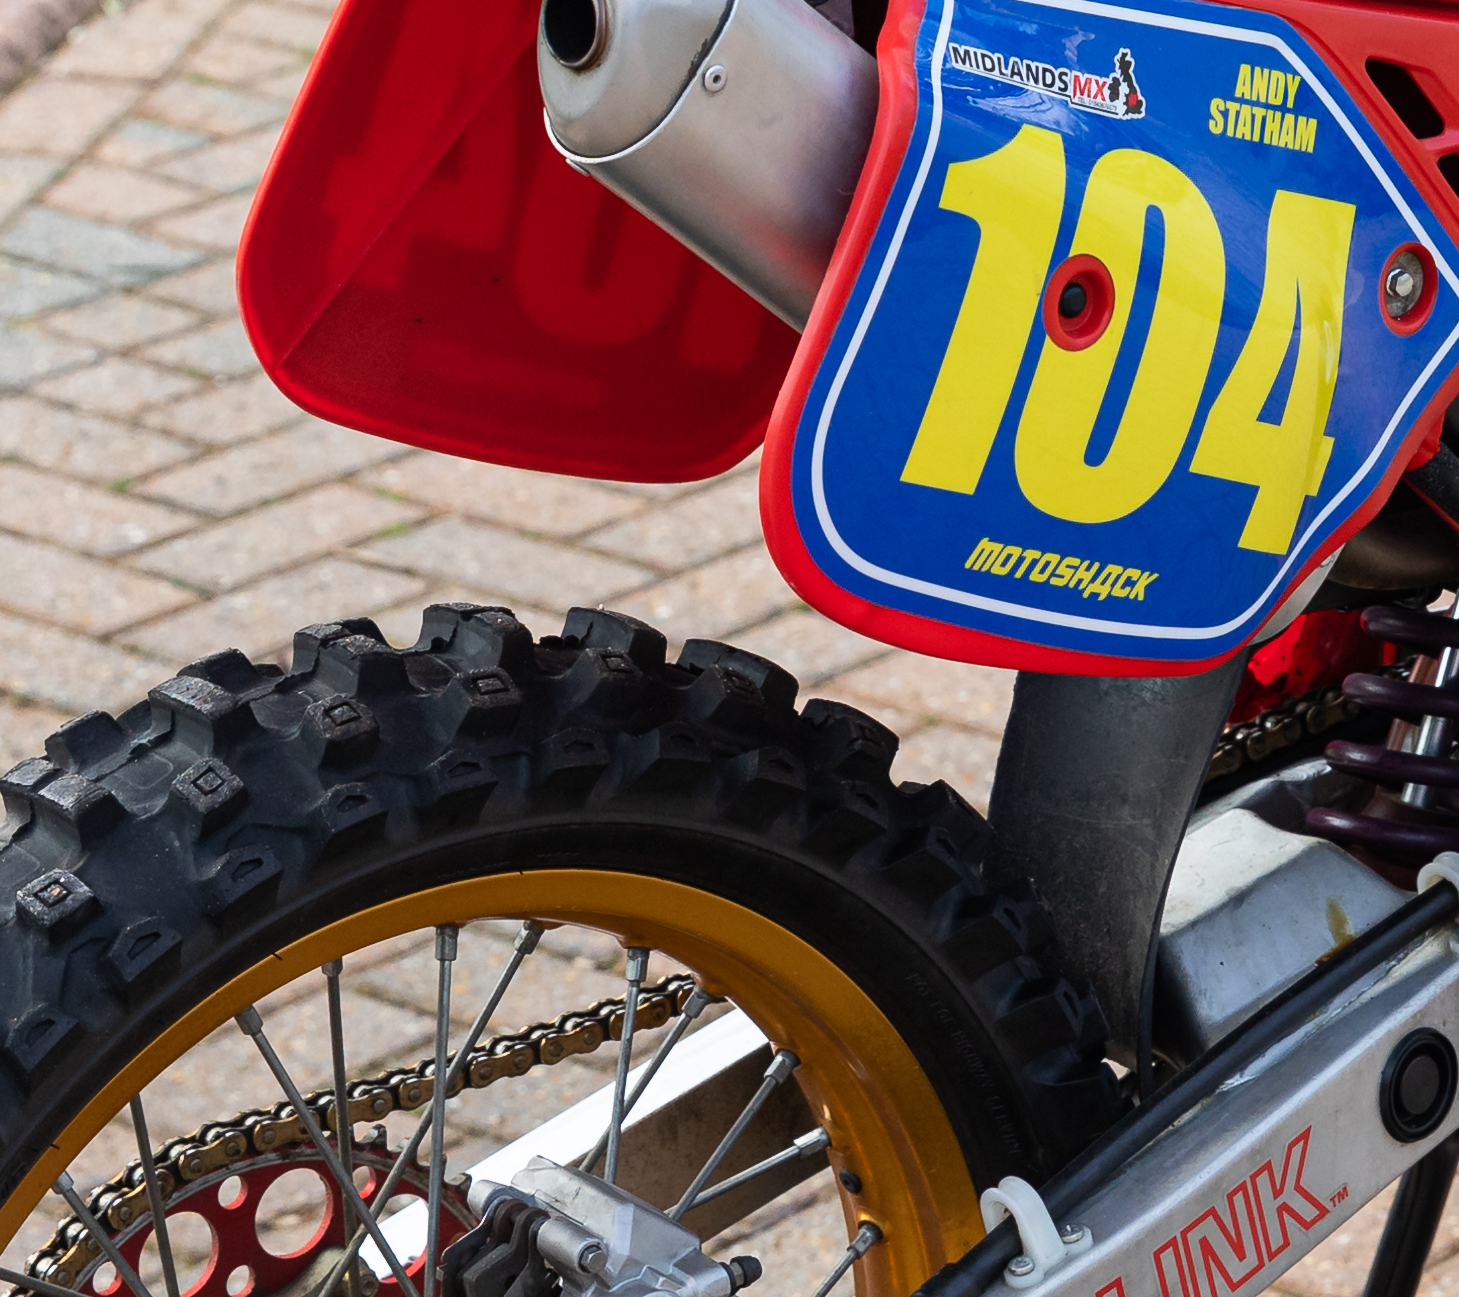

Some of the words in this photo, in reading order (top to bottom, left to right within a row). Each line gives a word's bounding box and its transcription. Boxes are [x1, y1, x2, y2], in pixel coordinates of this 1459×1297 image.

[1235, 63, 1302, 110] ANDY
[1209, 97, 1317, 154] STATHAM
[899, 123, 1357, 556] 104
[964, 536, 1159, 603] MOTOSHACK
